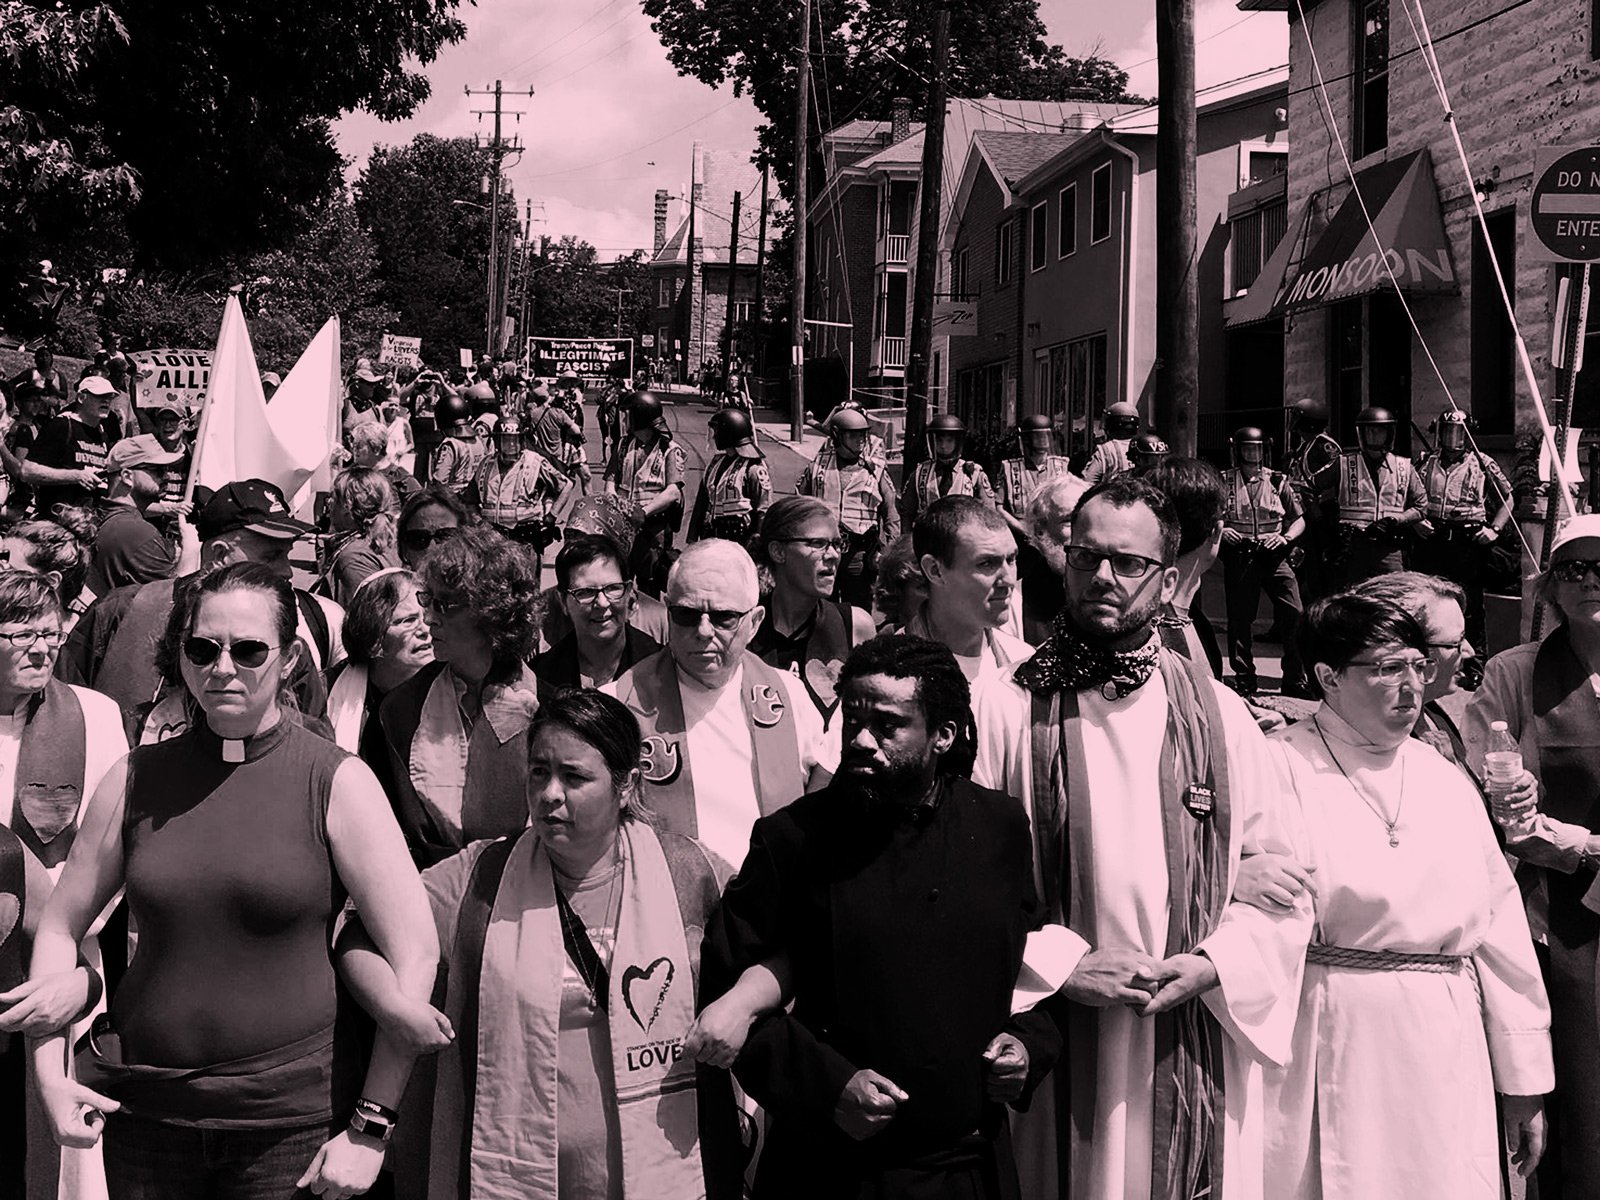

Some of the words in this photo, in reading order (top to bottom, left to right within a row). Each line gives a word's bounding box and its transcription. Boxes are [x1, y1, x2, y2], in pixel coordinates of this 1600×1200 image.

[1557, 171, 1581, 187] DO
[1556, 220, 1600, 236] ENTE
[1285, 248, 1454, 305] MONSOON
[151, 354, 211, 367] LOVE
[540, 349, 626, 361] ILLEGITIMATE
[556, 362, 610, 371] FASCIST
[156, 370, 208, 389] ALL!
[501, 423, 519, 433] VSP
[1012, 466, 1021, 500] STATE
[1349, 460, 1358, 494] STATE
[1190, 785, 1211, 797] BLACK
[1190, 794, 1211, 804] LIVES
[626, 1043, 683, 1071] LOVE
